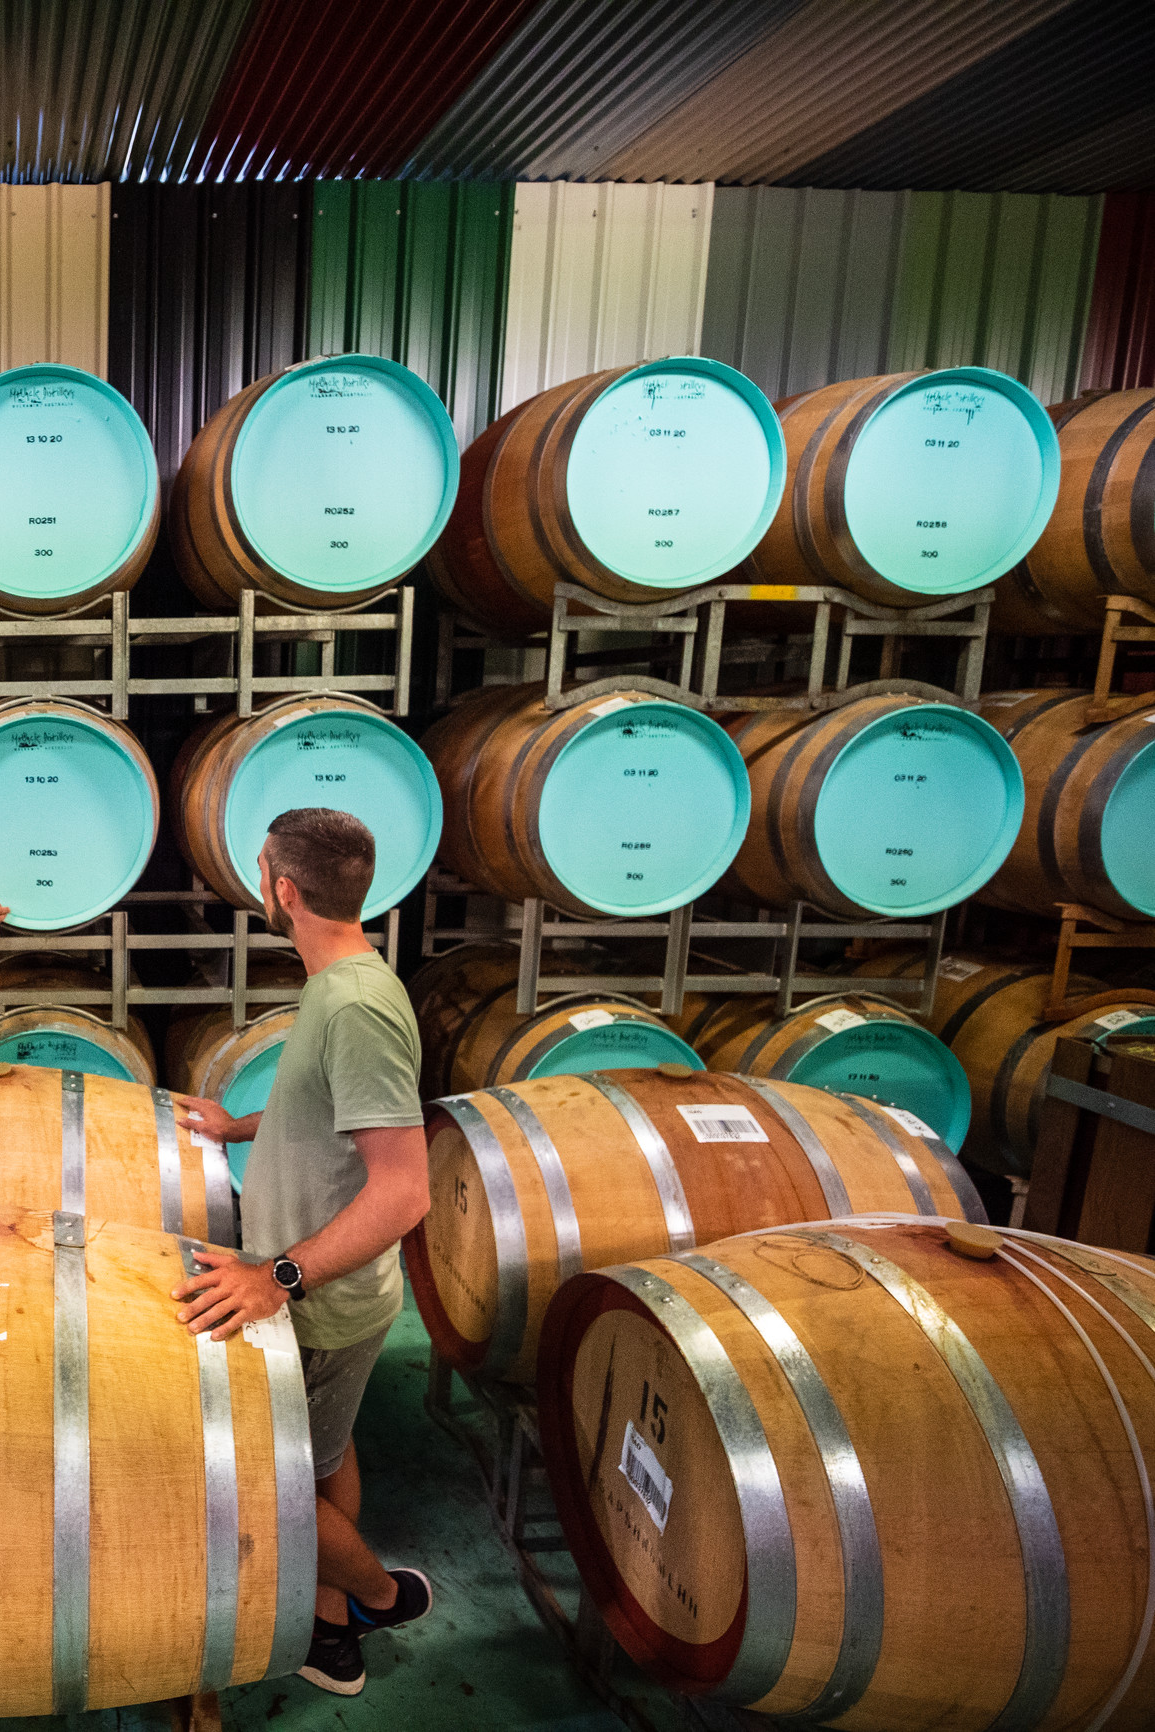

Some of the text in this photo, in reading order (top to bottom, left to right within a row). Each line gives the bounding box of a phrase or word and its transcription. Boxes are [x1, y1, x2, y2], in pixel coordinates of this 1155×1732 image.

[28, 516, 57, 525] R0251
[329, 540, 350, 550] 300
[654, 539, 674, 548] 300
[34, 548, 54, 557] 300
[920, 549, 939, 559] 300
[35, 878, 54, 888] 300
[455, 1175, 468, 1216] 15
[639, 1380, 669, 1445] 15
